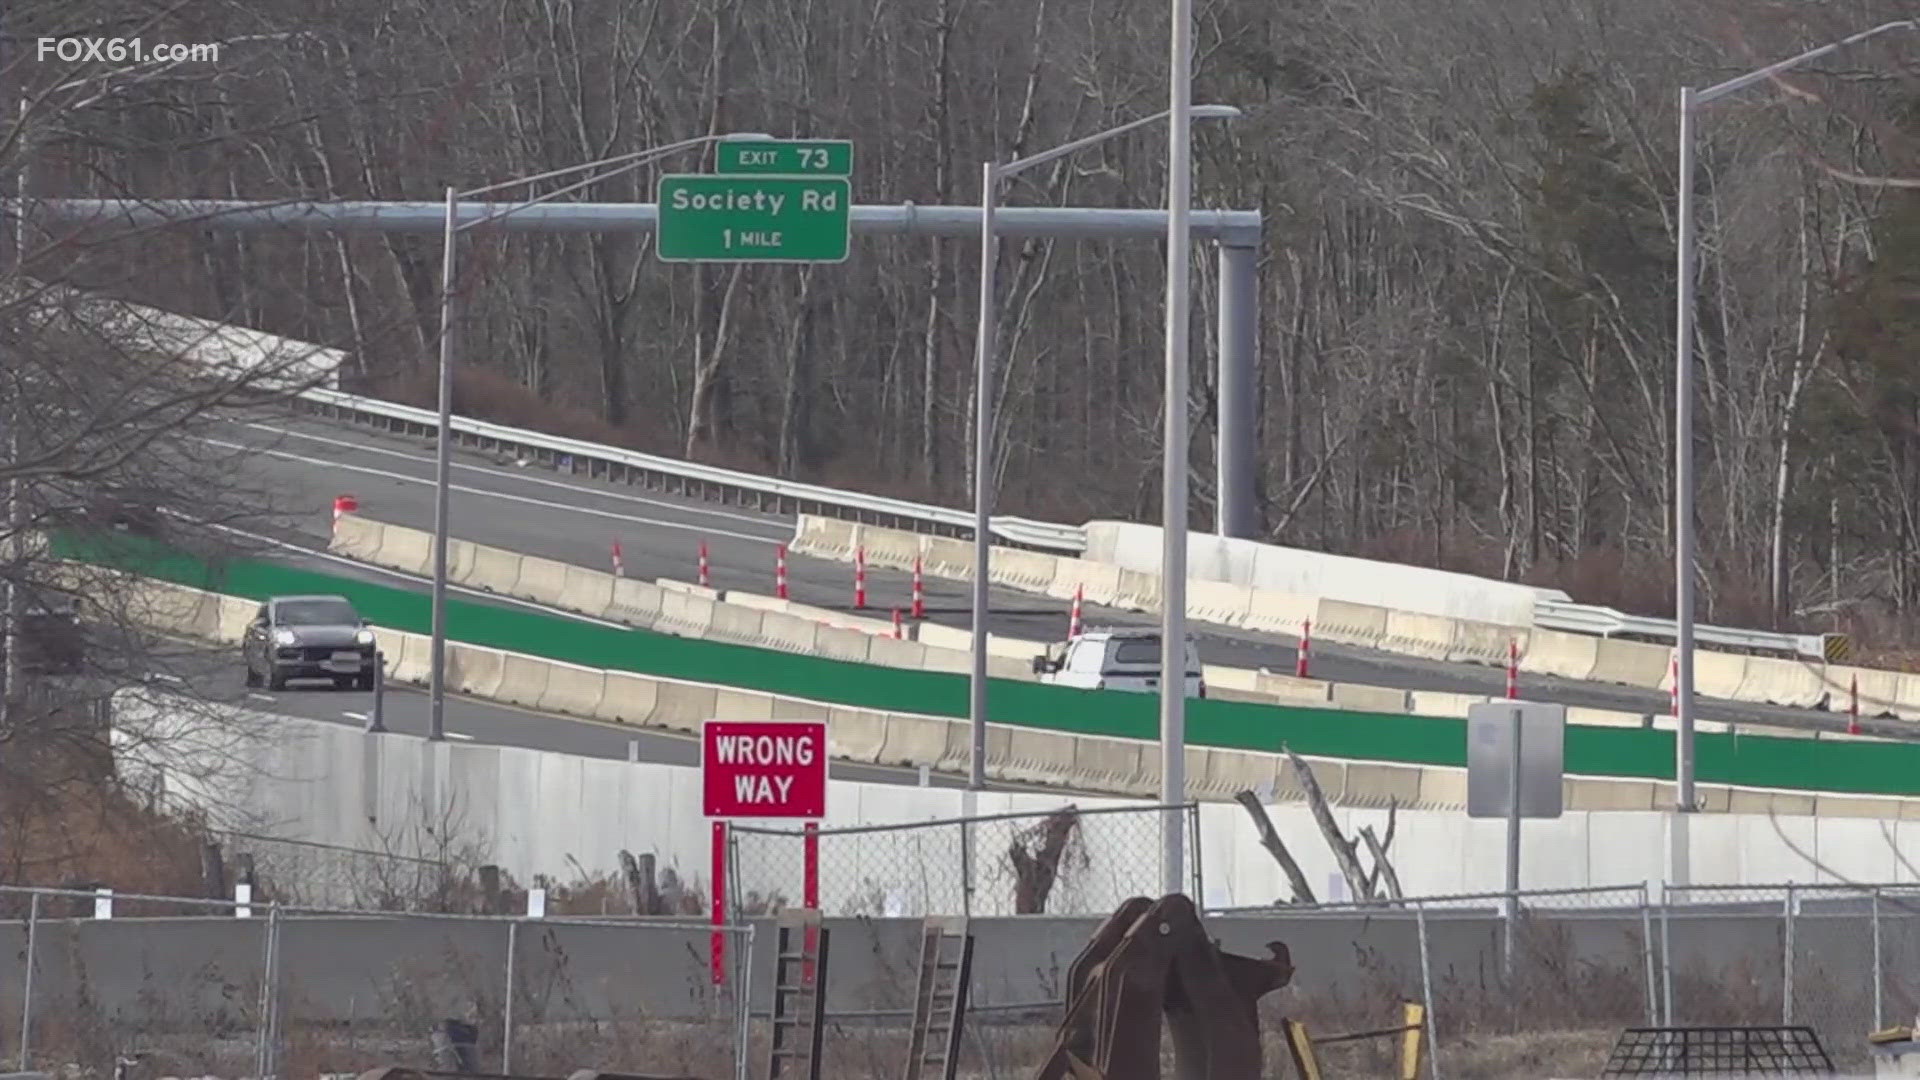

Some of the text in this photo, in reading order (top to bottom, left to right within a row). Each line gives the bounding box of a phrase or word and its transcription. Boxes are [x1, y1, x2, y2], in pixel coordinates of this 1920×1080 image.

[739, 148, 829, 169] EXIT 73
[672, 188, 836, 215] Society Rd
[723, 228, 782, 249] 1 MILE
[716, 734, 814, 766] WRONG
[734, 774, 794, 804] WAY
